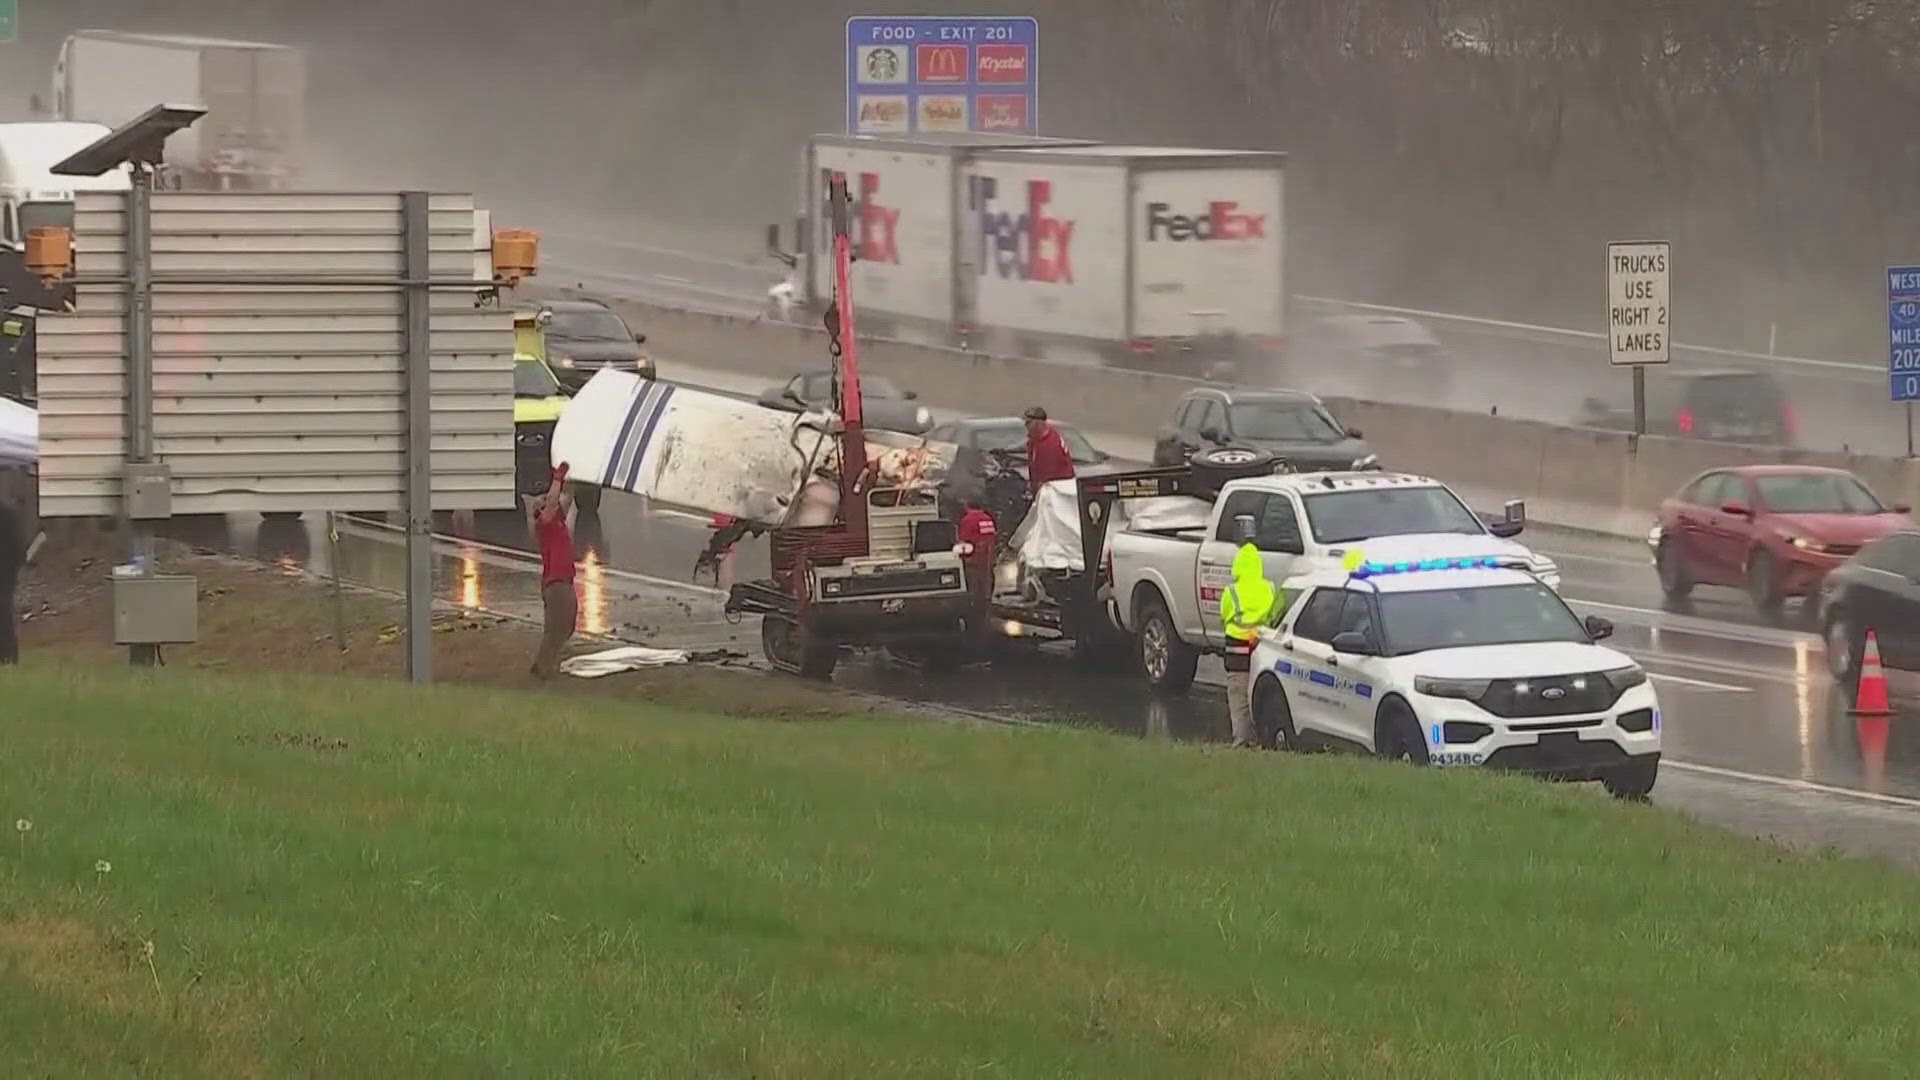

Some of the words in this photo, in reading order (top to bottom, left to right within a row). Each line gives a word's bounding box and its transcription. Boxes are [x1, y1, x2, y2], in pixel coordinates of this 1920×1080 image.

[872, 27, 915, 39] FOOD
[940, 27, 976, 39] EXIT
[985, 27, 1013, 39] 201
[969, 175, 1076, 285] FedEx
[1147, 201, 1268, 242] FedEx
[1613, 255, 1665, 273] TRUCKS
[1625, 281, 1654, 299] USE
[1612, 307, 1650, 326] RIGHT
[1657, 306, 1666, 325] 2
[1899, 303, 1916, 316] 40
[1617, 333, 1662, 352] LANES
[1891, 328, 1920, 344] MILE
[1893, 348, 1920, 369] 202
[1430, 753, 1482, 765] 9434BC
